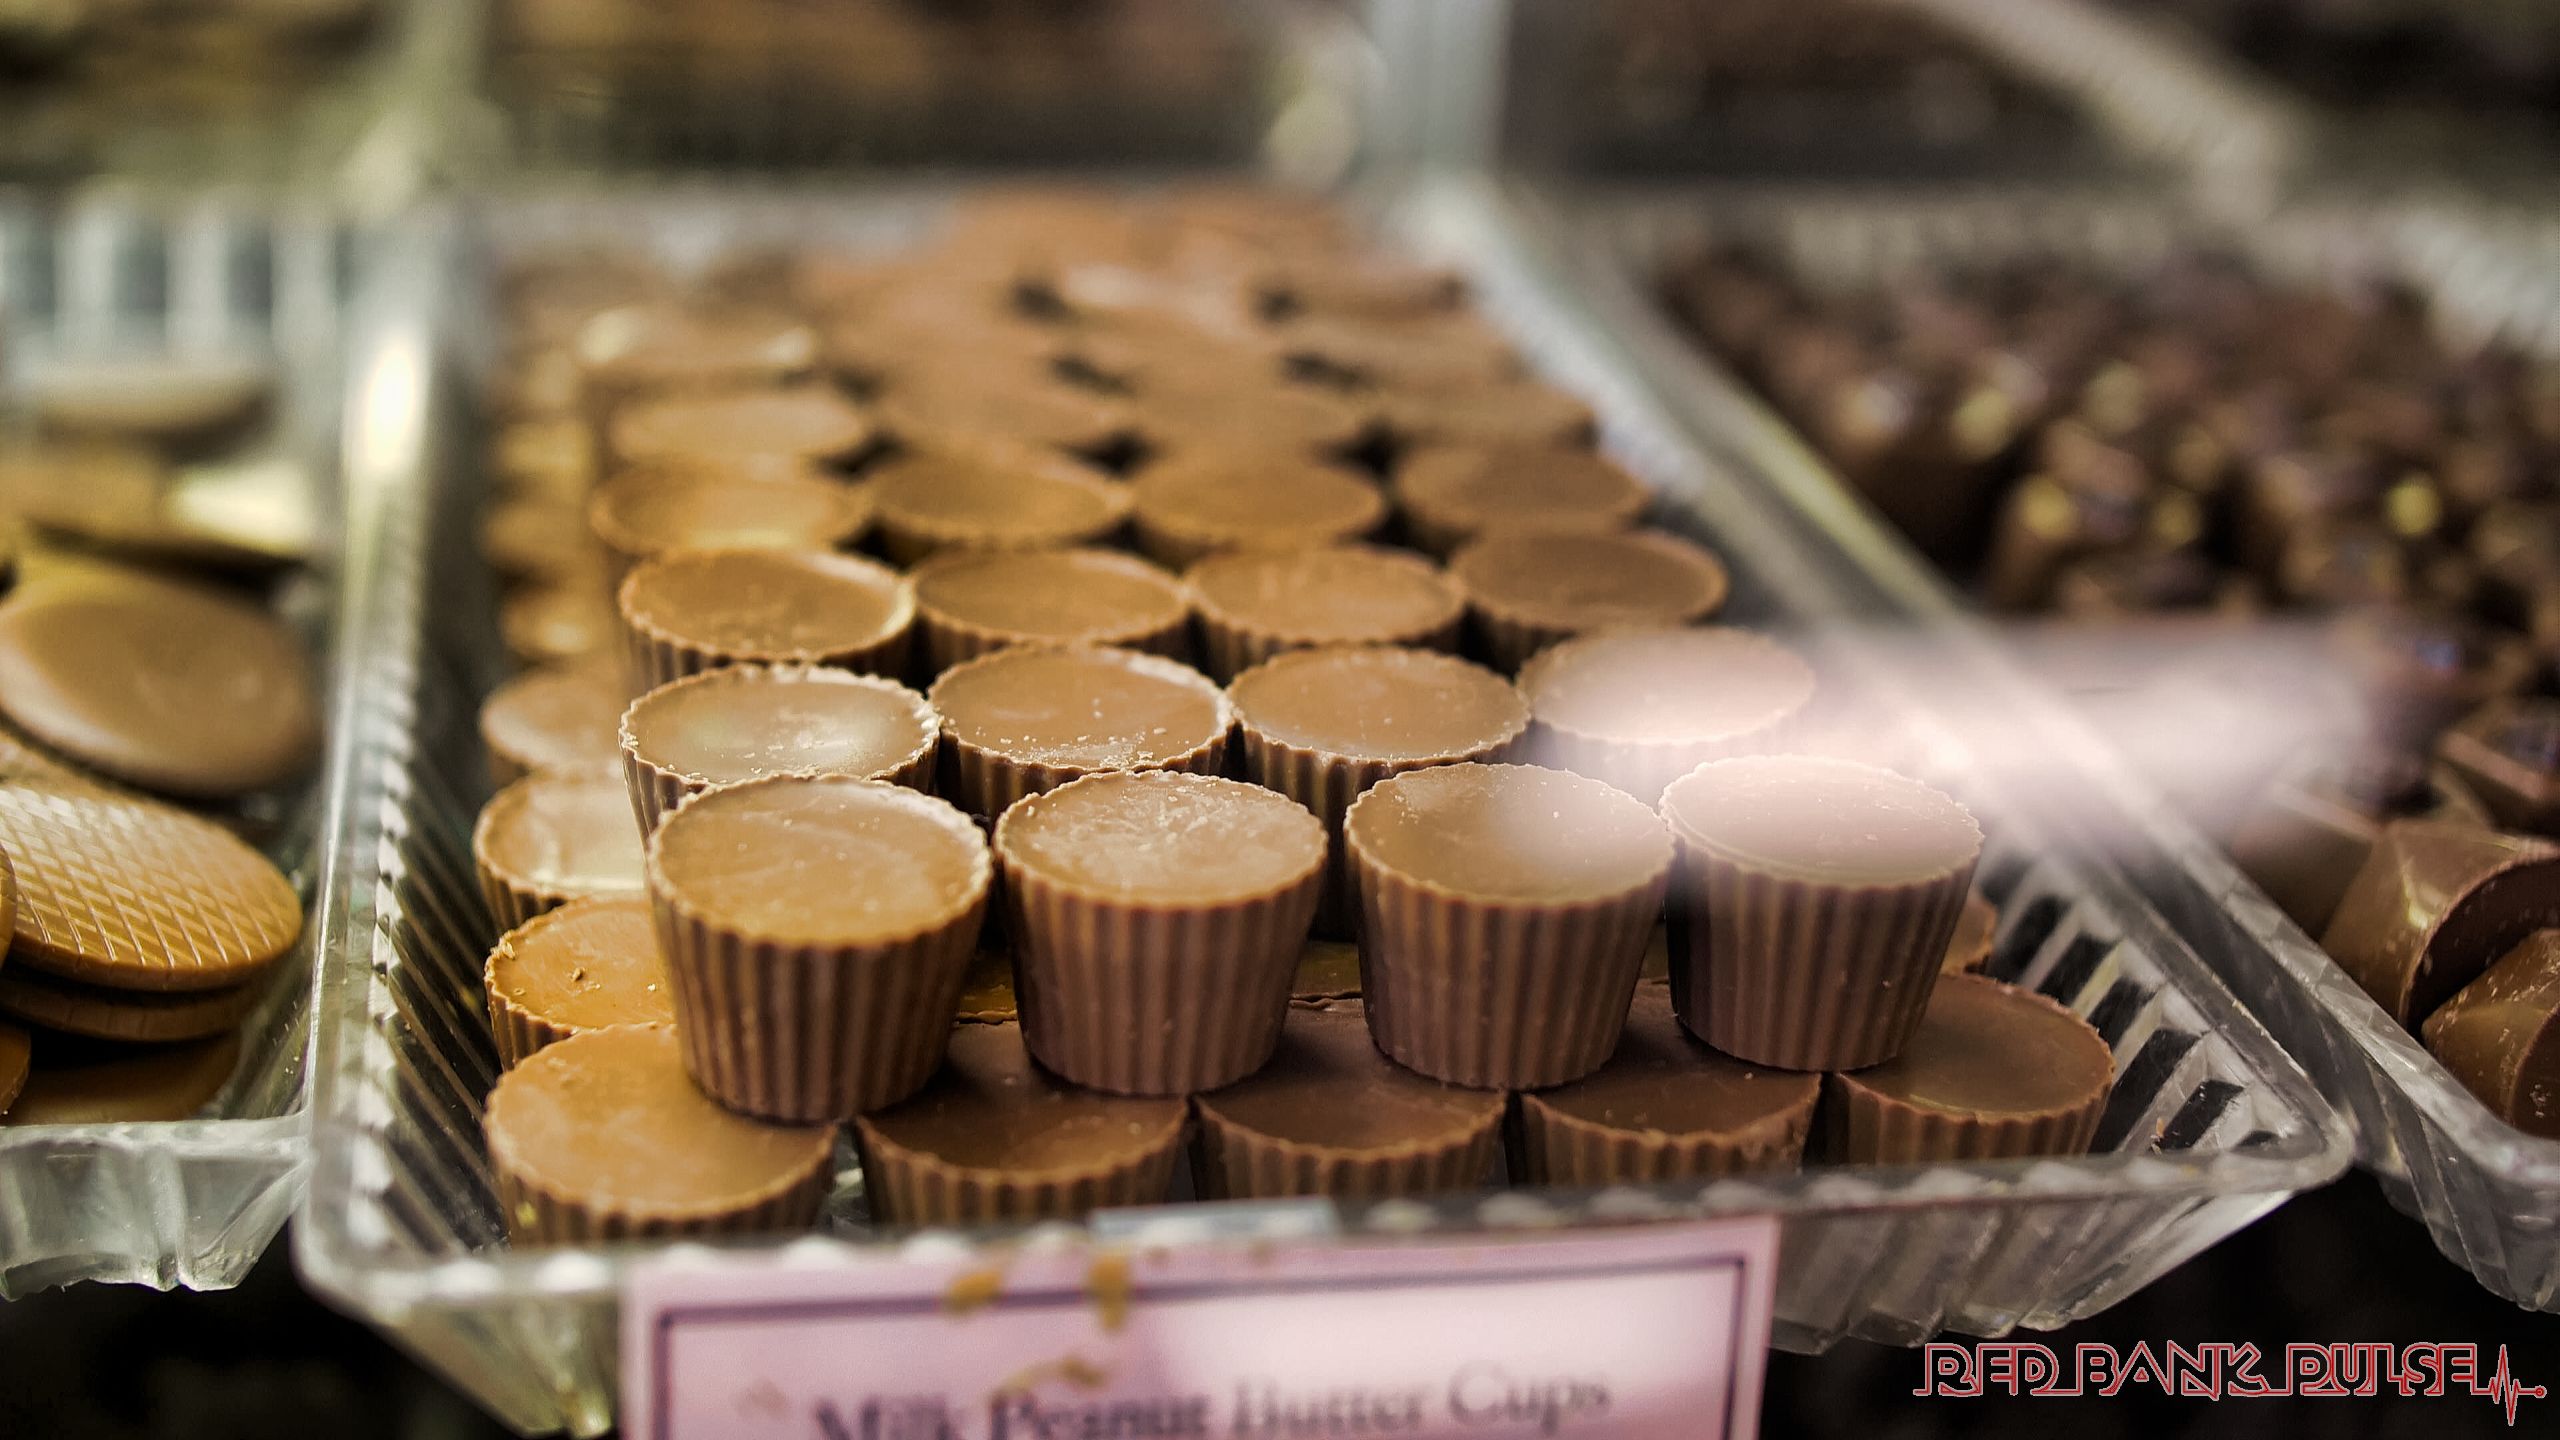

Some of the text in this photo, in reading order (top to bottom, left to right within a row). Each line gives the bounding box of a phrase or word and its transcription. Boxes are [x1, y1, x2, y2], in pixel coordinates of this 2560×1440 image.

[988, 1389, 1212, 1440] Peanut
[1230, 1372, 1428, 1439] Butter
[1446, 1359, 1612, 1437] Cups
